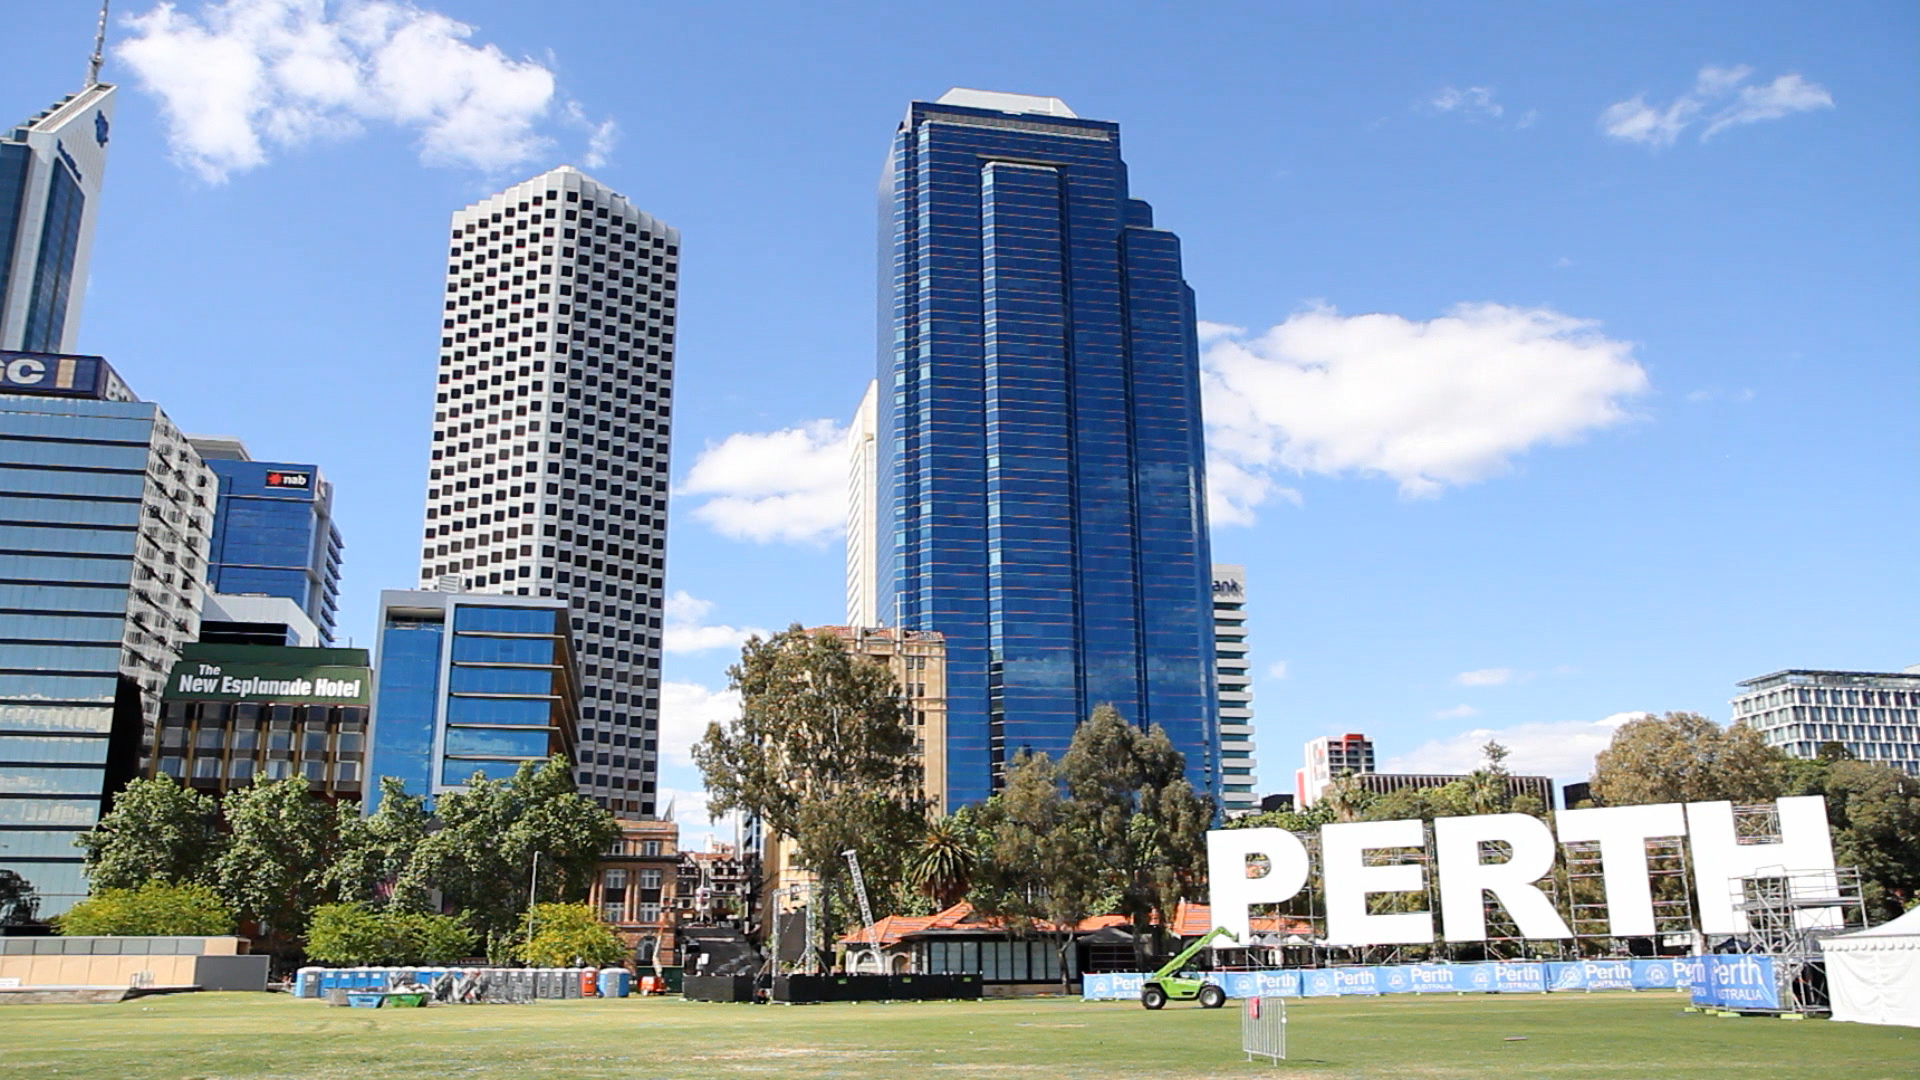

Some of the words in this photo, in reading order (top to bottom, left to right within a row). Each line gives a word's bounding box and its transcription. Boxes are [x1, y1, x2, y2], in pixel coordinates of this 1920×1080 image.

[0, 358, 45, 384] C
[283, 475, 306, 485] nab
[199, 664, 221, 675] The
[179, 674, 219, 693] New
[221, 676, 311, 697] Esplanade
[314, 678, 361, 697] Hotel
[1206, 795, 1845, 946] PERTH
[1333, 970, 1375, 985] Perth
[1411, 967, 1453, 982] Perth
[1495, 965, 1539, 981] Perth
[1585, 963, 1632, 979] Perth
[1112, 976, 1144, 989] Pert
[1256, 974, 1296, 988] Perth
